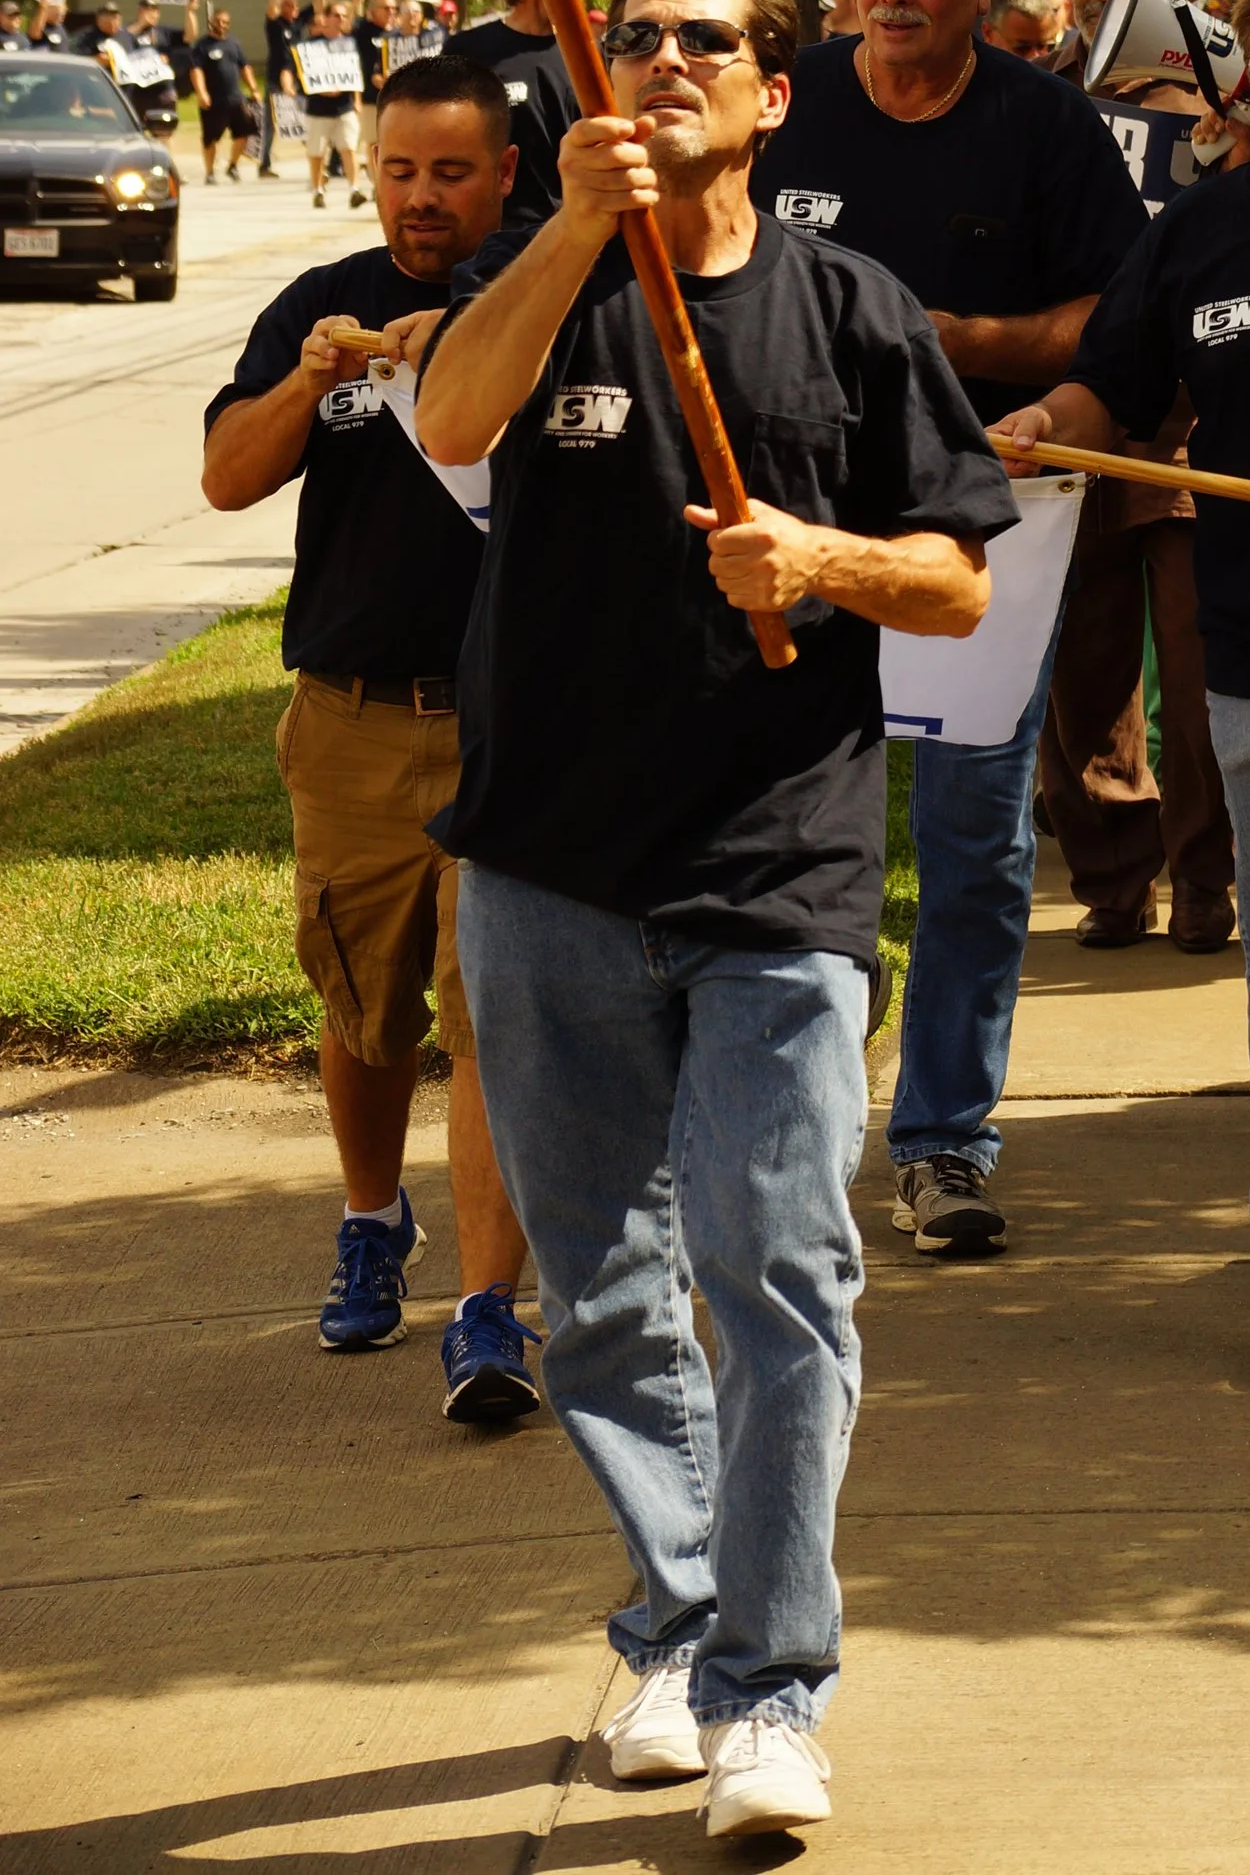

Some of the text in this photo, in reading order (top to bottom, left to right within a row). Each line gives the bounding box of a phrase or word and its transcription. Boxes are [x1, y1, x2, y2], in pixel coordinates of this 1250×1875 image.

[799, 190, 841, 200] STEELWORKERS
[774, 194, 844, 226] USW
[1194, 303, 1213, 313] UNITED
[1207, 333, 1238, 347] LOCAL 979
[318, 385, 382, 421] USW
[332, 420, 365, 432] LOCAL 979
[558, 439, 597, 449] LOCAL 979
